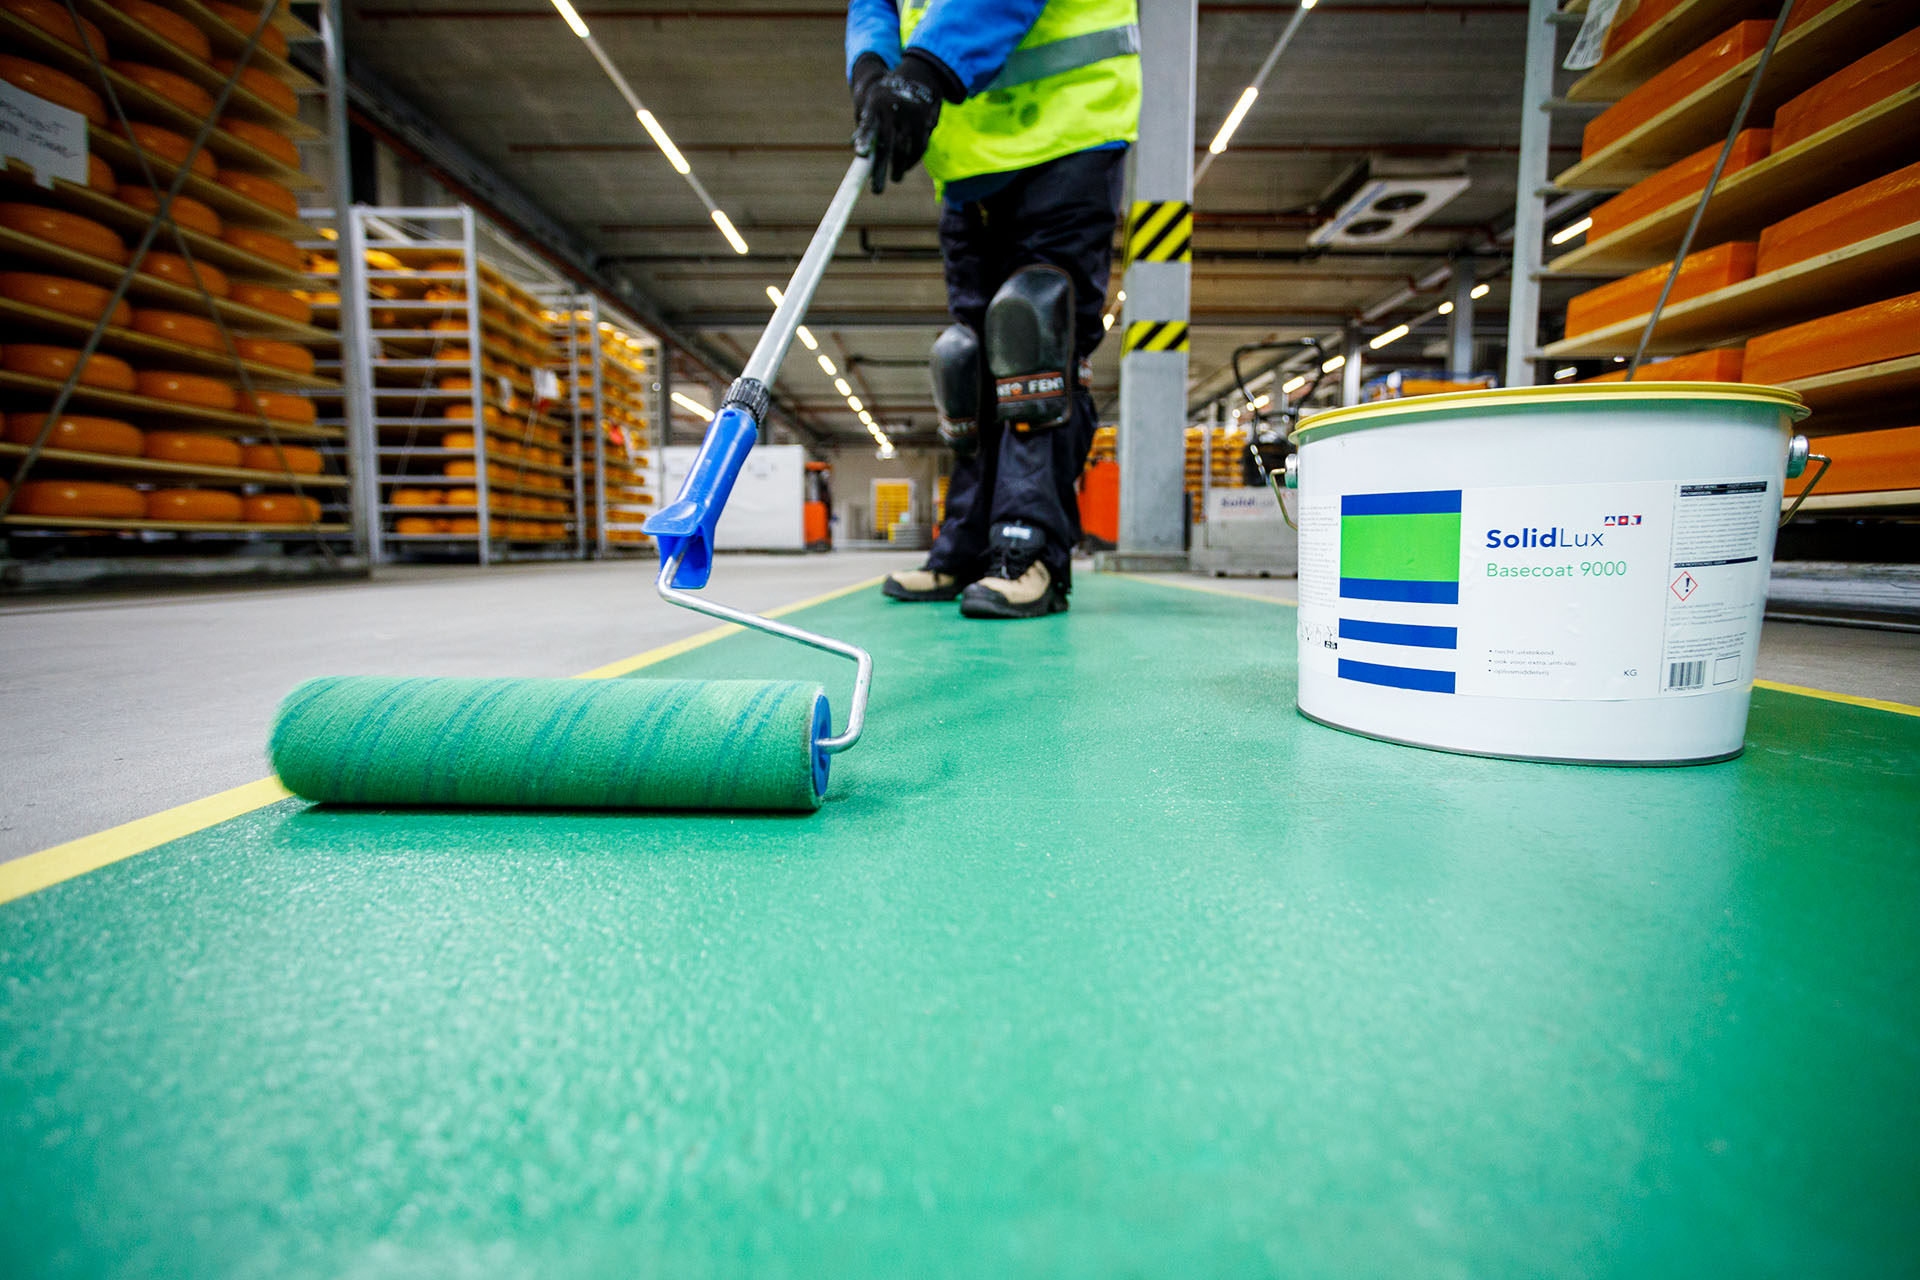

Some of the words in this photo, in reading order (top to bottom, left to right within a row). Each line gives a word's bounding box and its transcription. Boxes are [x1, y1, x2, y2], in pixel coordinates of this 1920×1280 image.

[1486, 527, 1604, 549] SolidLux
[1486, 563, 1574, 577] Basecoat
[1580, 561, 1627, 576] 9000
[1623, 668, 1638, 677] KG
